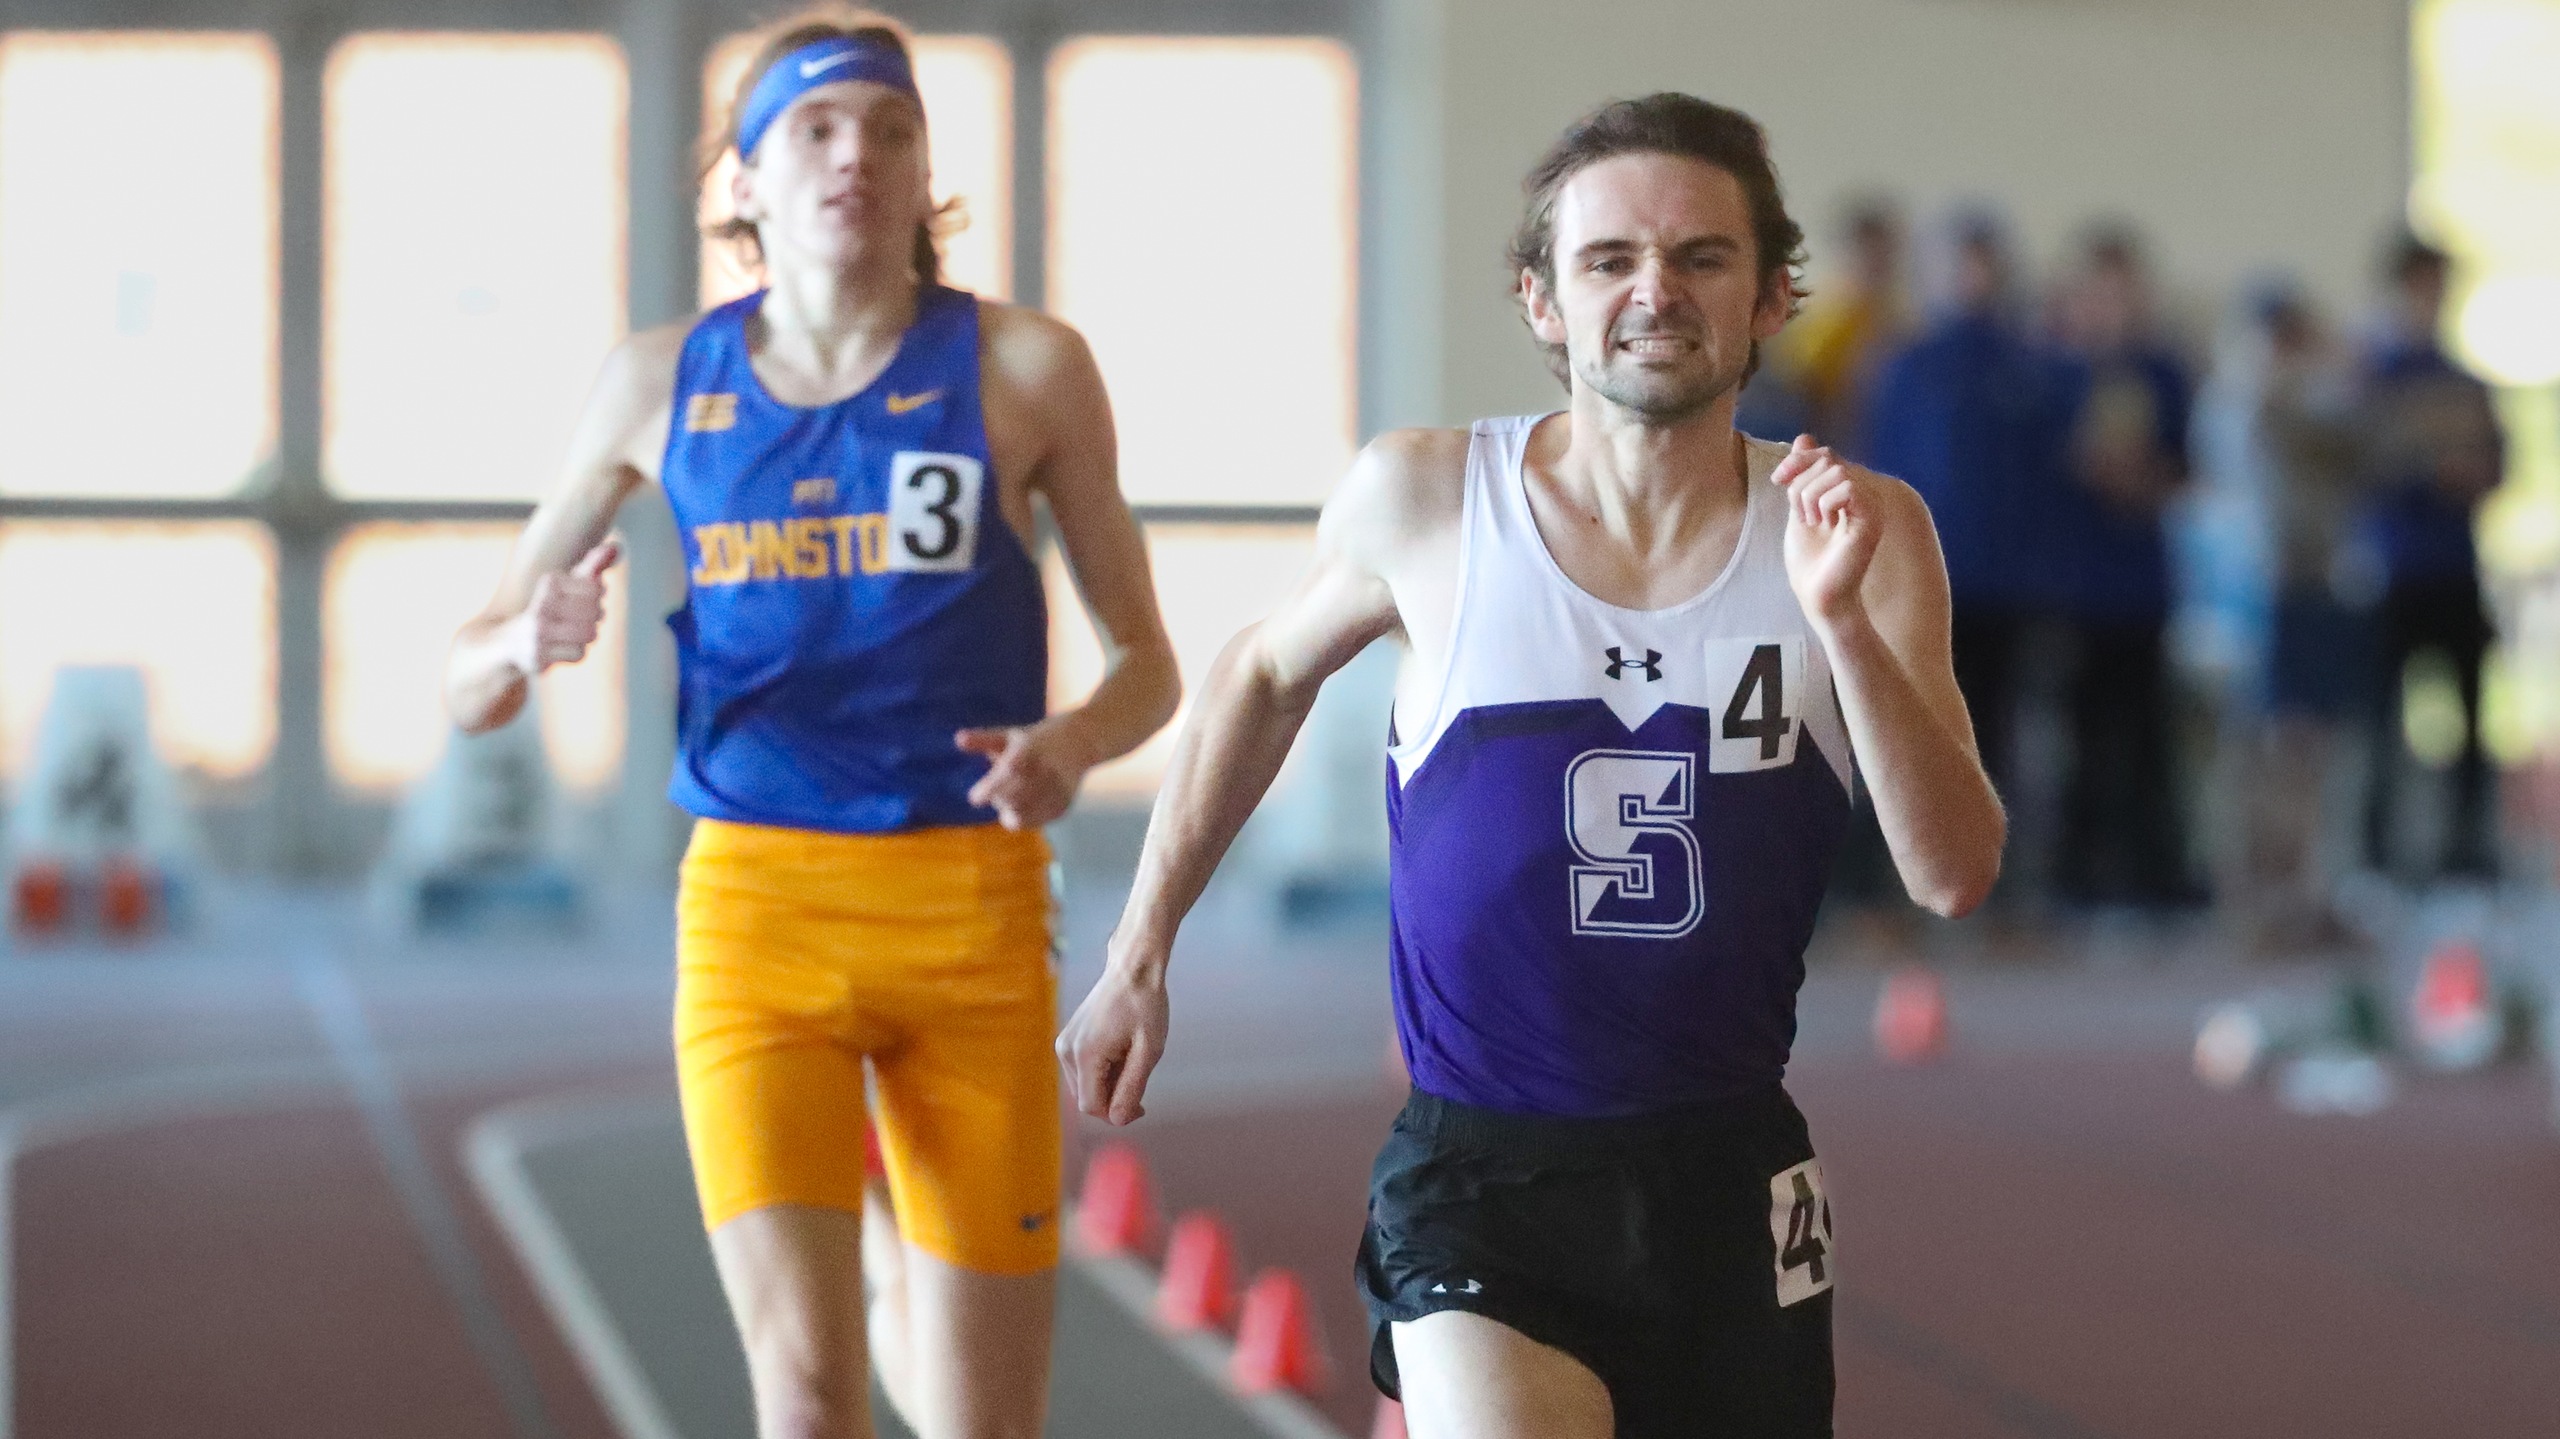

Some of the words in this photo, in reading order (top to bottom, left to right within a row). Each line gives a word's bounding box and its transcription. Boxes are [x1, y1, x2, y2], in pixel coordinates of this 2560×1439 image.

[904, 465, 961, 559] 3
[1722, 643, 1791, 762] 4
[1565, 748, 1705, 939] S
[1781, 1171, 1827, 1285] 4
